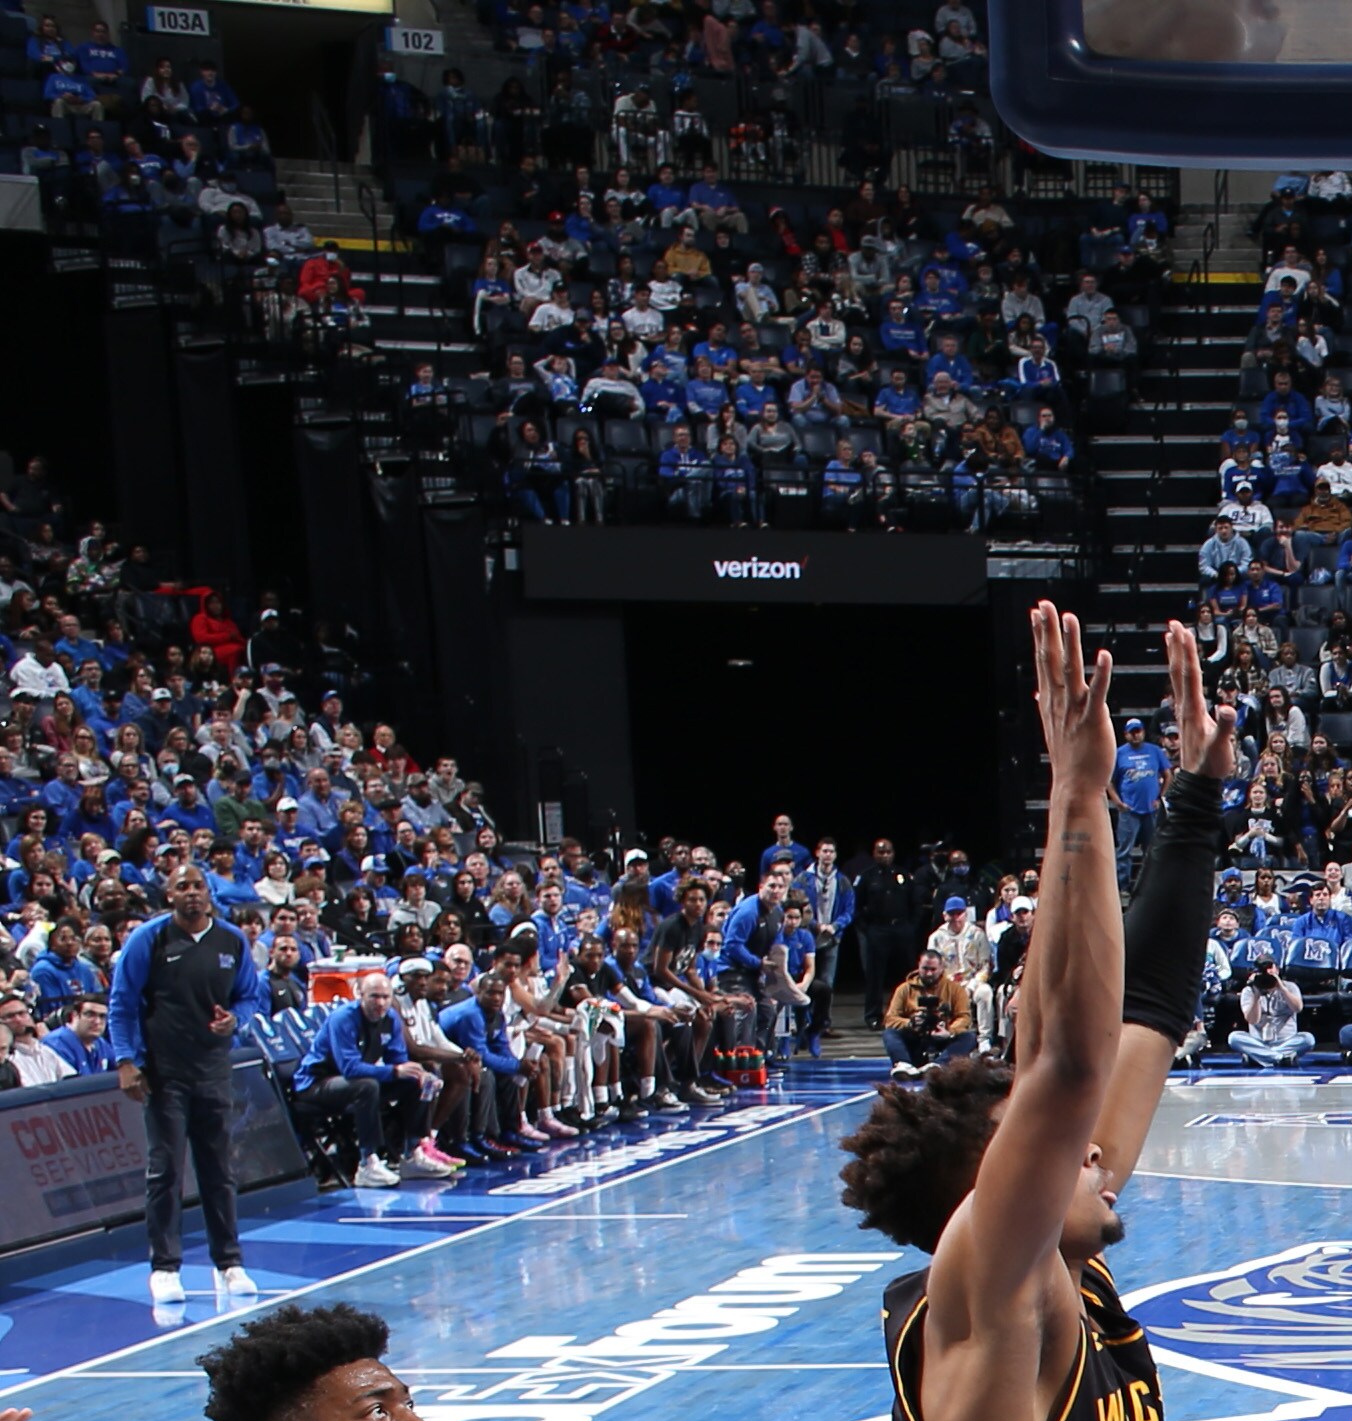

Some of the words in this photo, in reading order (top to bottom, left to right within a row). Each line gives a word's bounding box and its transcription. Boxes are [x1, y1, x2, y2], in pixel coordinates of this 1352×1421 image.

[157, 11, 206, 32] 103A
[401, 31, 434, 51] 102
[713, 556, 801, 579] verizon
